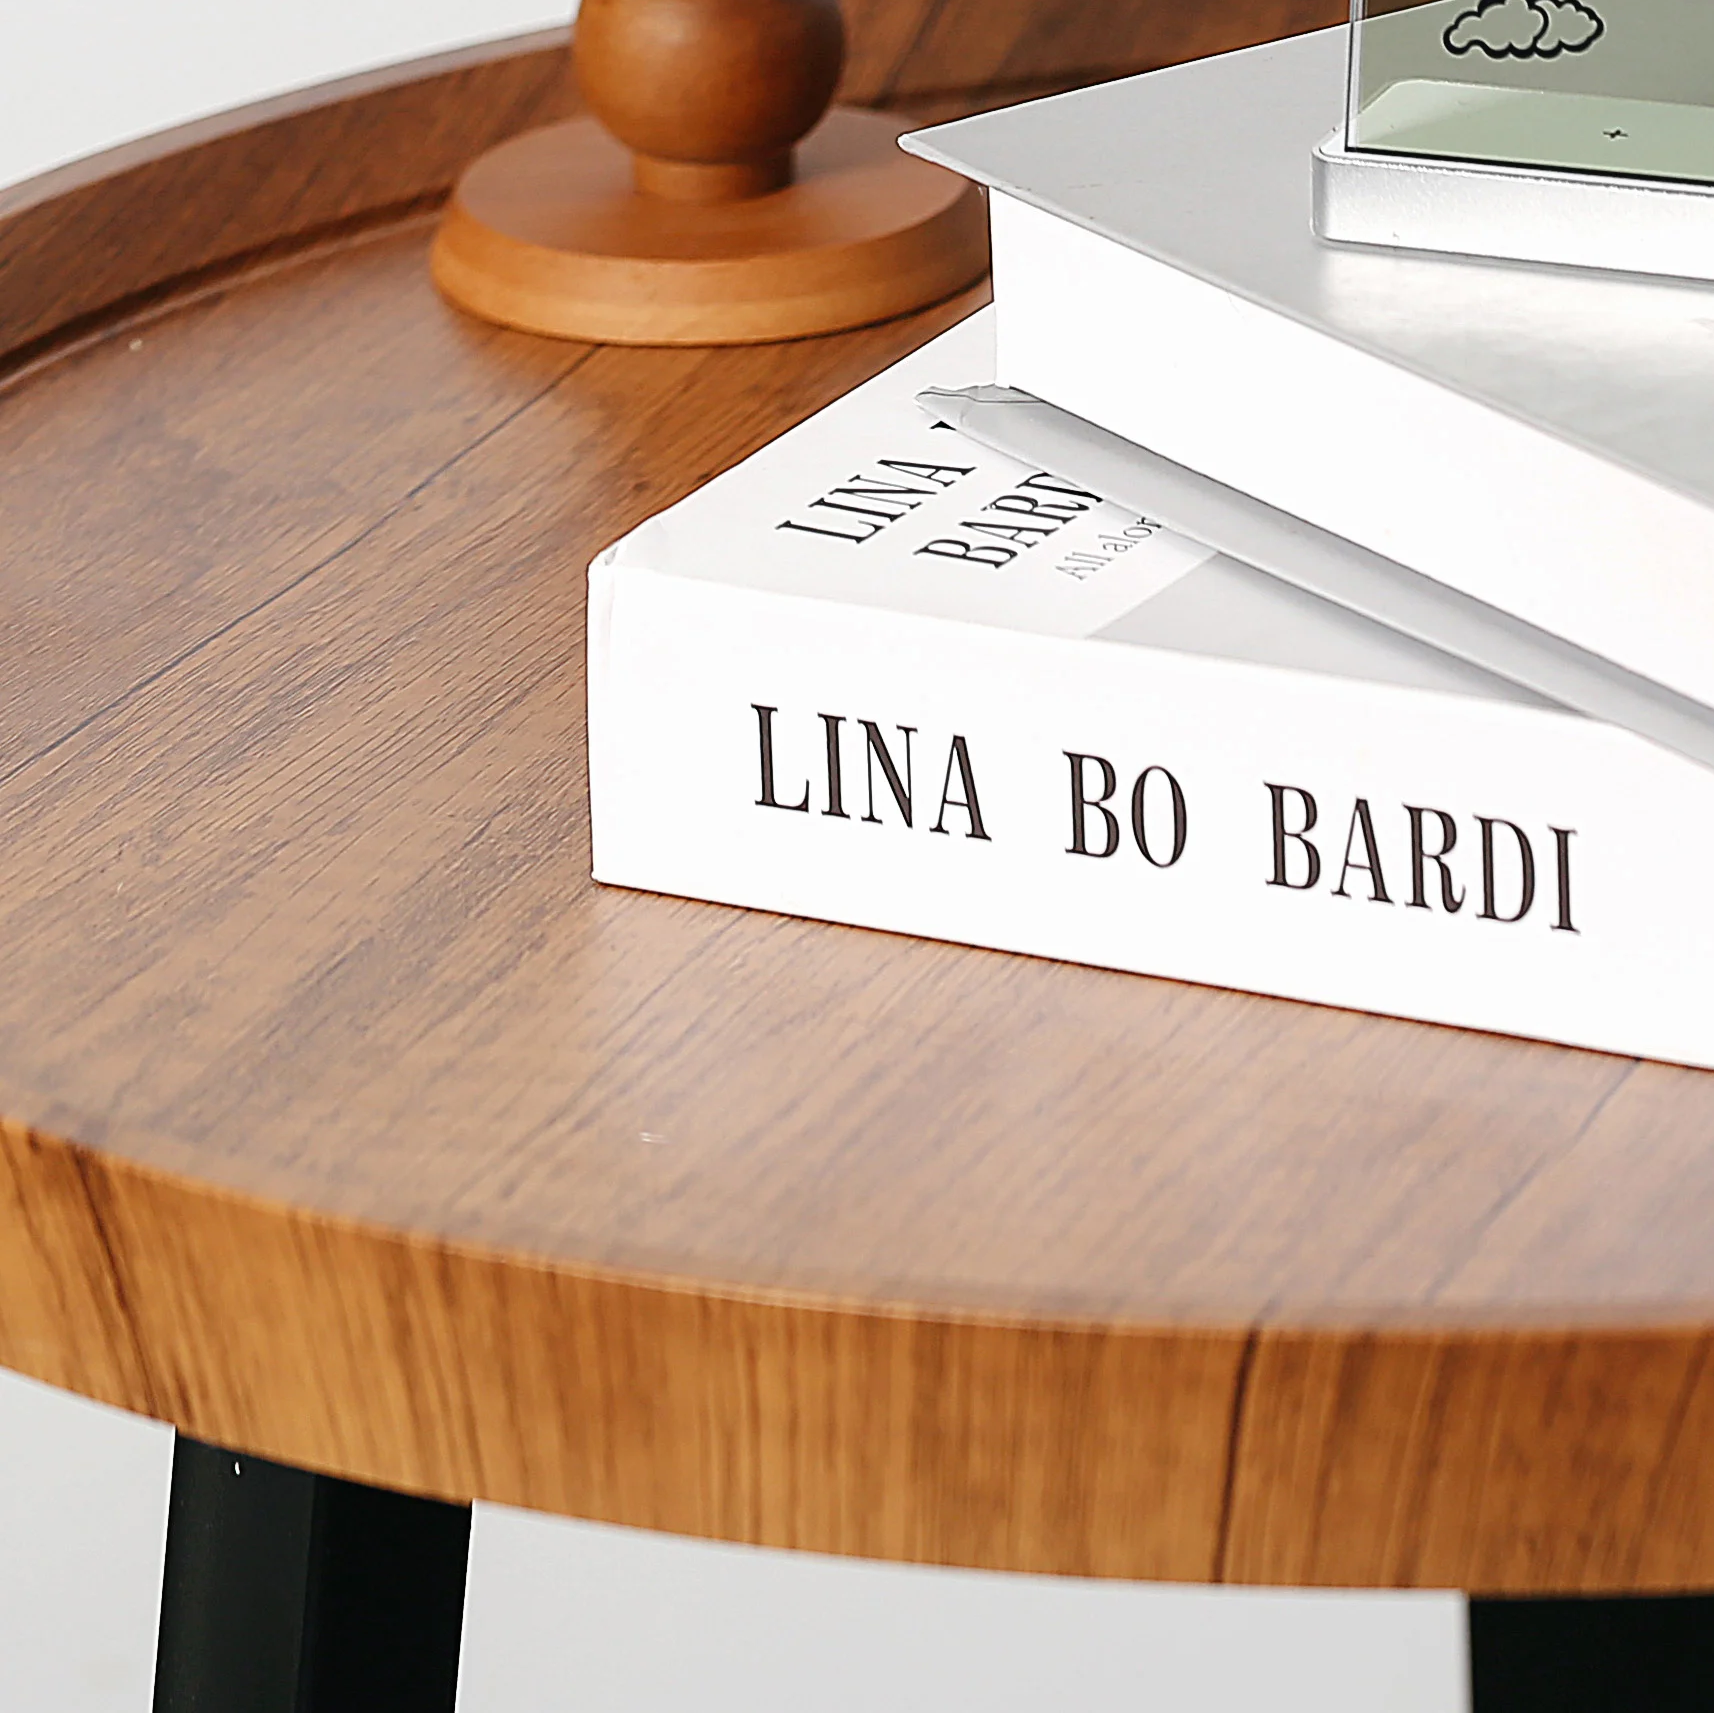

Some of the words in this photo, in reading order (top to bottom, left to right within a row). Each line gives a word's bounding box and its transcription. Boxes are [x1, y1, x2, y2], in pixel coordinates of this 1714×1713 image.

[775, 458, 978, 545] LINA
[1054, 551, 1116, 581] All
[750, 703, 992, 842] LINA
[1062, 750, 1188, 868] BO
[1263, 782, 1579, 933] BARDI
